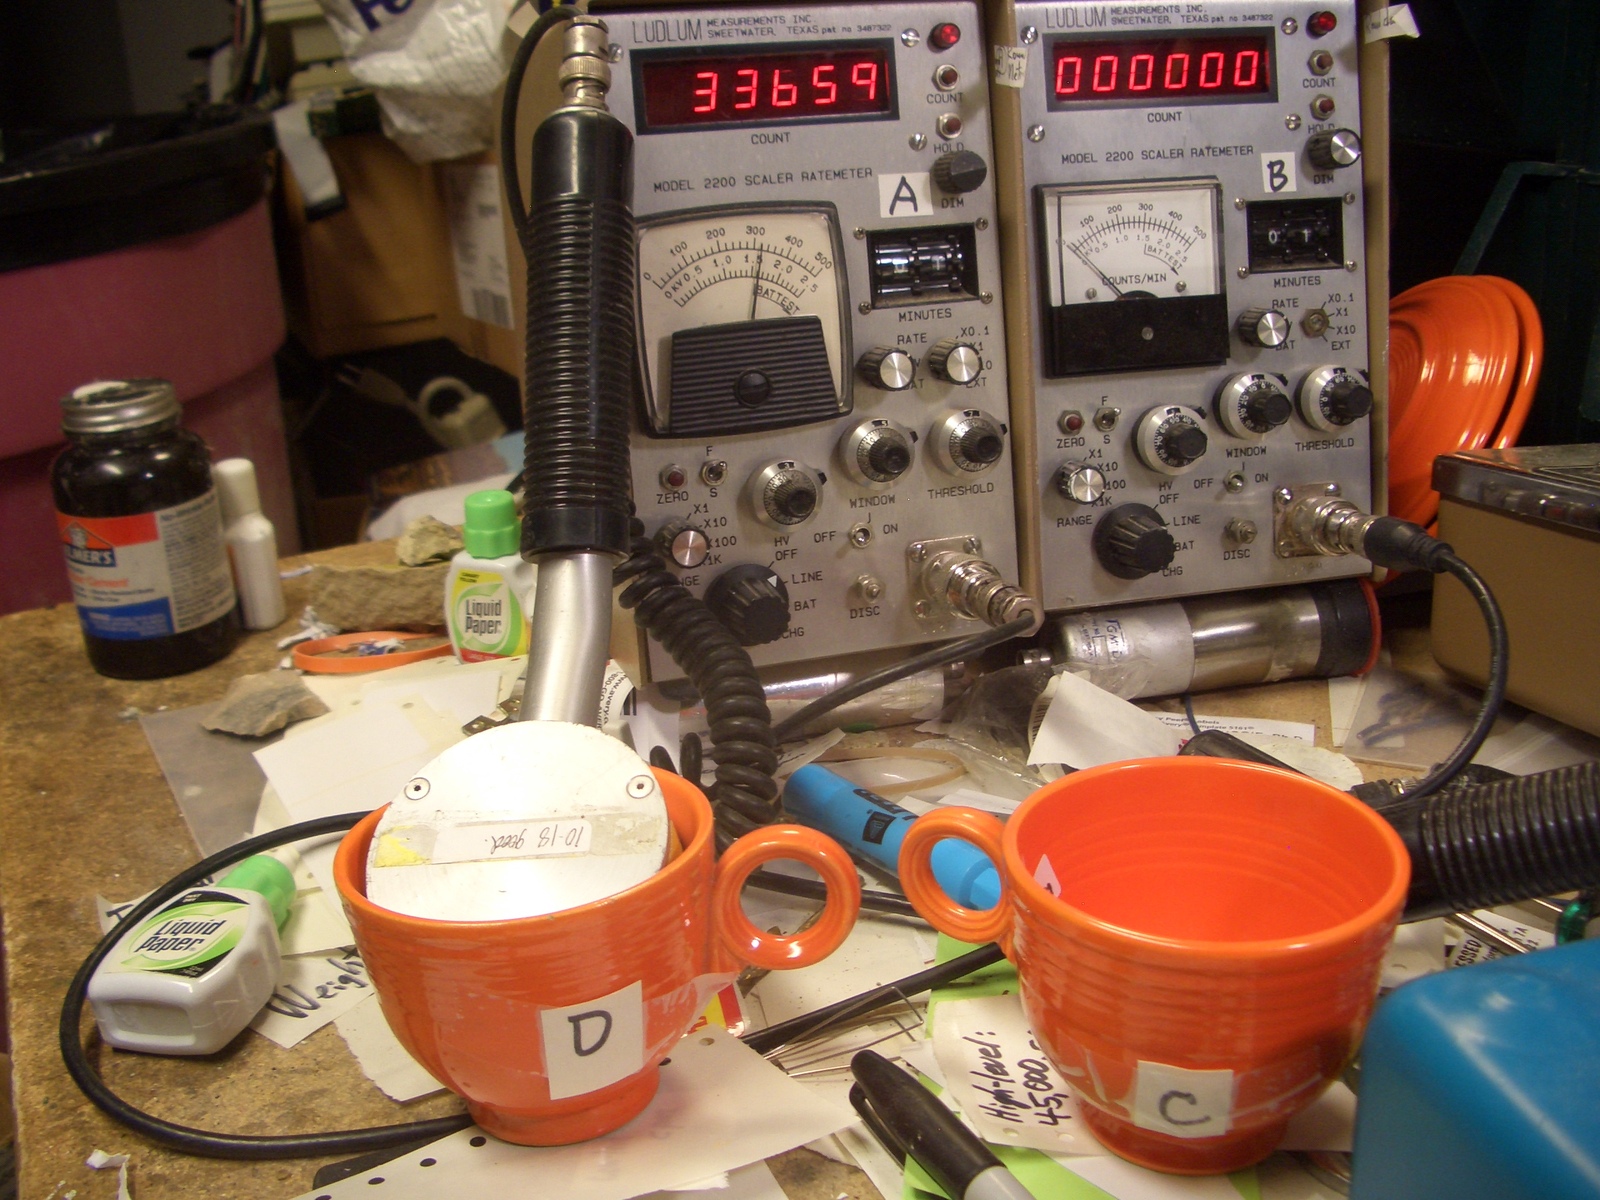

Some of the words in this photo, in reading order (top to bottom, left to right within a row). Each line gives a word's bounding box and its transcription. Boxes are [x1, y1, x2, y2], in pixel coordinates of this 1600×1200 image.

[1110, 4, 1181, 15] MEASUREMENTS
[707, 15, 786, 27] MEASUREMENTS
[1045, 7, 1107, 29] LUDLUM
[1181, 13, 1209, 24] TEXAS
[633, 19, 702, 43] LUDLUM
[788, 24, 819, 35] TEXAS
[821, 27, 836, 36] pat
[857, 24, 892, 33] 3487322
[1055, 50, 1259, 94] 000000
[694, 62, 878, 113] 33659
[1302, 77, 1336, 89] COUNT
[927, 92, 964, 105] COUNT
[1147, 111, 1182, 123] COUNT
[751, 132, 791, 145] COUNT
[933, 141, 965, 154] HOLD
[1061, 152, 1098, 165] MODEL
[1105, 150, 1134, 162] 2200
[1141, 148, 1185, 160] SCALER
[1190, 145, 1254, 158] RATEMETER
[653, 179, 695, 192] MODEL
[703, 176, 736, 189] 2200
[744, 172, 794, 185] SCALER
[801, 167, 873, 182] RATEMETER
[1267, 160, 1288, 192] B
[1313, 174, 1334, 184] DIM
[889, 175, 918, 215] A
[941, 196, 965, 209] DIM
[1080, 215, 1094, 228] 100
[1107, 204, 1122, 214] 200
[1138, 203, 1154, 211] 300
[1168, 210, 1183, 221] 400
[1193, 225, 1207, 240] 500
[669, 241, 688, 257] 100
[705, 227, 726, 240] 200
[745, 225, 766, 236] 300
[784, 234, 804, 248] 400
[814, 251, 833, 270] 500
[1115, 234, 1129, 243] 1.0
[1157, 238, 1171, 249] 2.0
[1175, 250, 1188, 263] 2.5
[683, 265, 703, 282] 0.5
[713, 254, 732, 268] 1.0
[773, 259, 793, 274] 2.0
[800, 275, 819, 294] 2.5
[1102, 273, 1167, 286] COUNTS/MIN
[1273, 276, 1322, 287] MINUTES
[1271, 298, 1300, 310] RATE
[1328, 293, 1354, 304] X0.1
[898, 308, 952, 322] MINUTES
[1335, 307, 1349, 317] X1
[961, 326, 989, 337] X0.1
[1336, 325, 1356, 335] X10
[897, 333, 928, 345] RATE
[1331, 340, 1351, 351] EXT
[1101, 396, 1109, 406] F
[1057, 437, 1085, 448] ZERO
[1103, 435, 1111, 445] S
[1295, 438, 1354, 451] THRESHOLD
[706, 446, 714, 457] F
[1089, 449, 1102, 459] X1
[1226, 446, 1267, 458] WINDOW
[1098, 462, 1118, 472] X10
[1193, 478, 1213, 489] OFF
[1255, 473, 1269, 483] ON
[928, 483, 995, 499] THRESHOLD
[1105, 480, 1126, 490] 100
[1159, 481, 1173, 491] HV
[657, 491, 689, 505] ZERO
[709, 488, 718, 499] S
[1159, 493, 1180, 504] OFF
[849, 495, 896, 508] WINDOW
[694, 504, 709, 514] X1
[704, 517, 727, 528] X10
[1057, 515, 1092, 527] RANGE
[1173, 515, 1201, 527] LINE
[883, 524, 898, 535] ON
[774, 536, 790, 547] HV
[814, 531, 837, 543] OFF
[775, 549, 798, 561] OFF
[1223, 549, 1250, 560] DISC
[792, 571, 823, 584] LINE
[1162, 566, 1183, 577] CHG
[465, 599, 502, 618] Liquid
[794, 599, 816, 611] BAT
[850, 606, 880, 620] DISC
[465, 615, 502, 636] Paper
[156, 918, 227, 937] Liquid
[133, 936, 206, 953] Paper
[567, 1009, 613, 1057] D
[1158, 1090, 1211, 1126] C
